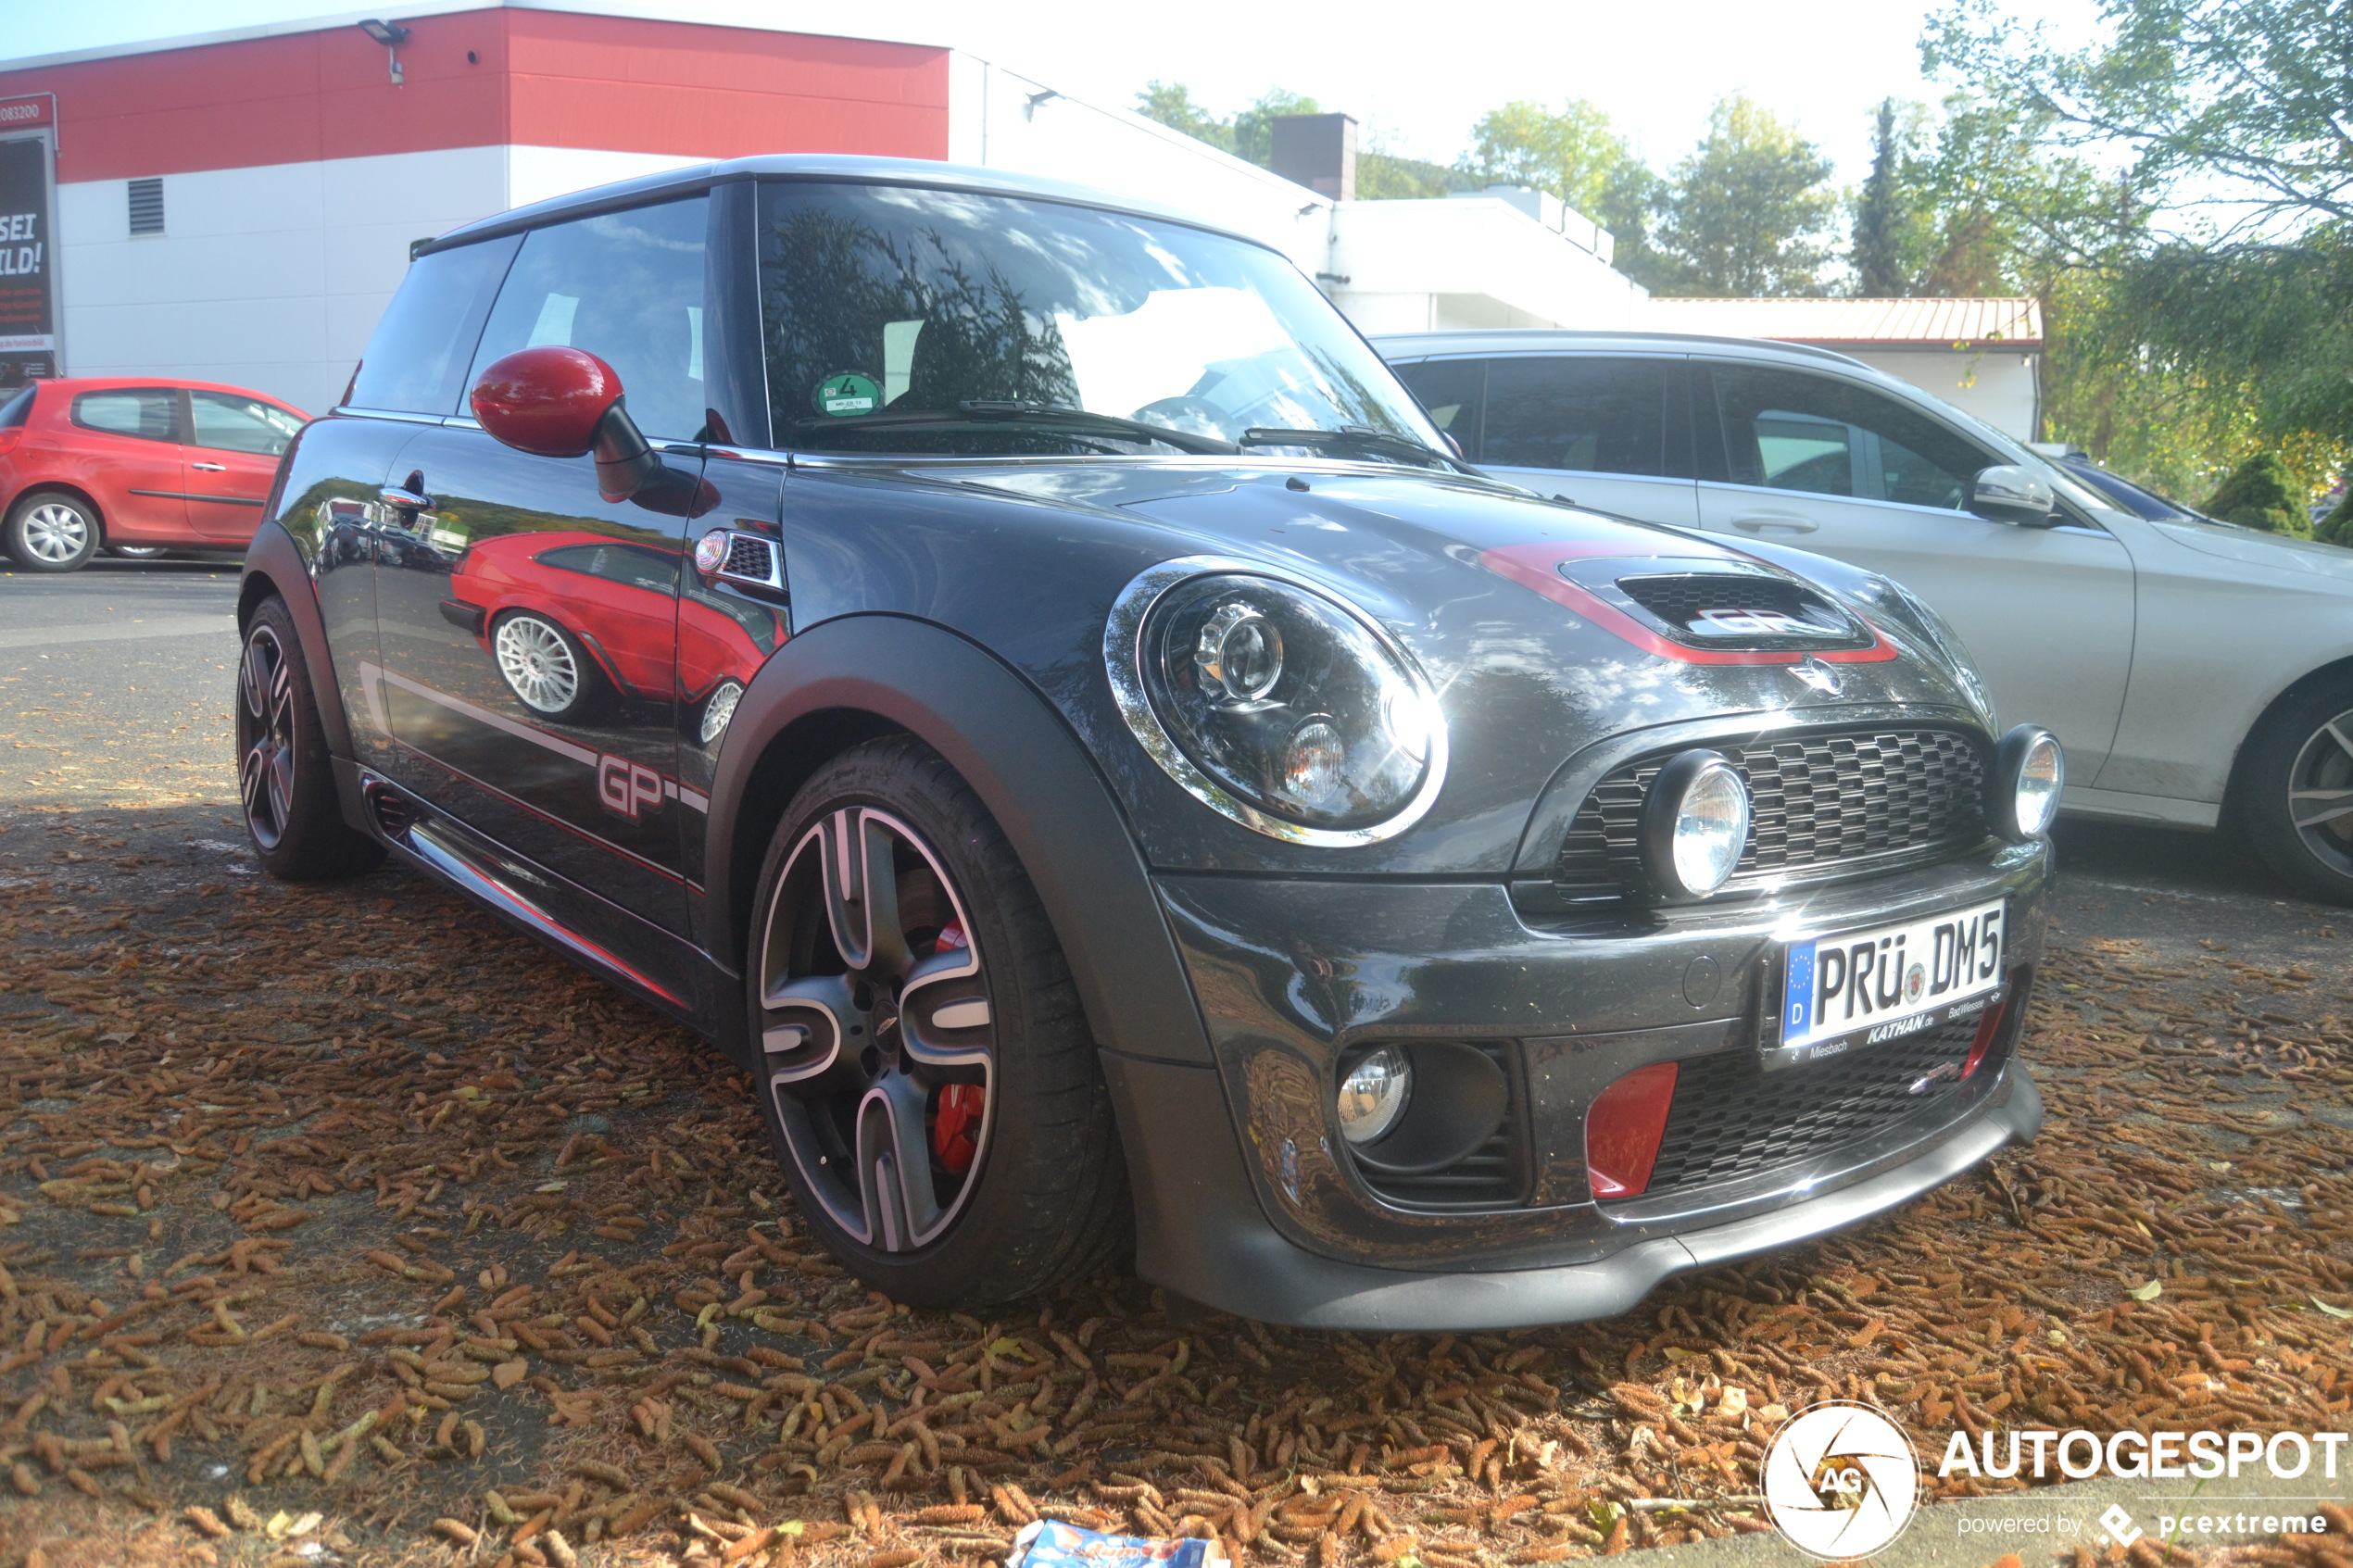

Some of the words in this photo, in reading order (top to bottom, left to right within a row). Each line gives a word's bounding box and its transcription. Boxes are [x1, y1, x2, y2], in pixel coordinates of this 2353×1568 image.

[0, 104, 40, 121] 083200
[839, 377, 857, 396] 4
[1696, 608, 1799, 633] GP
[598, 751, 662, 819] GP
[1814, 934, 1906, 1026] PRÜ
[1792, 1001, 1803, 1025] D
[1809, 1038, 1848, 1060] Miesbach
[1947, 1005, 1962, 1020] Bad
